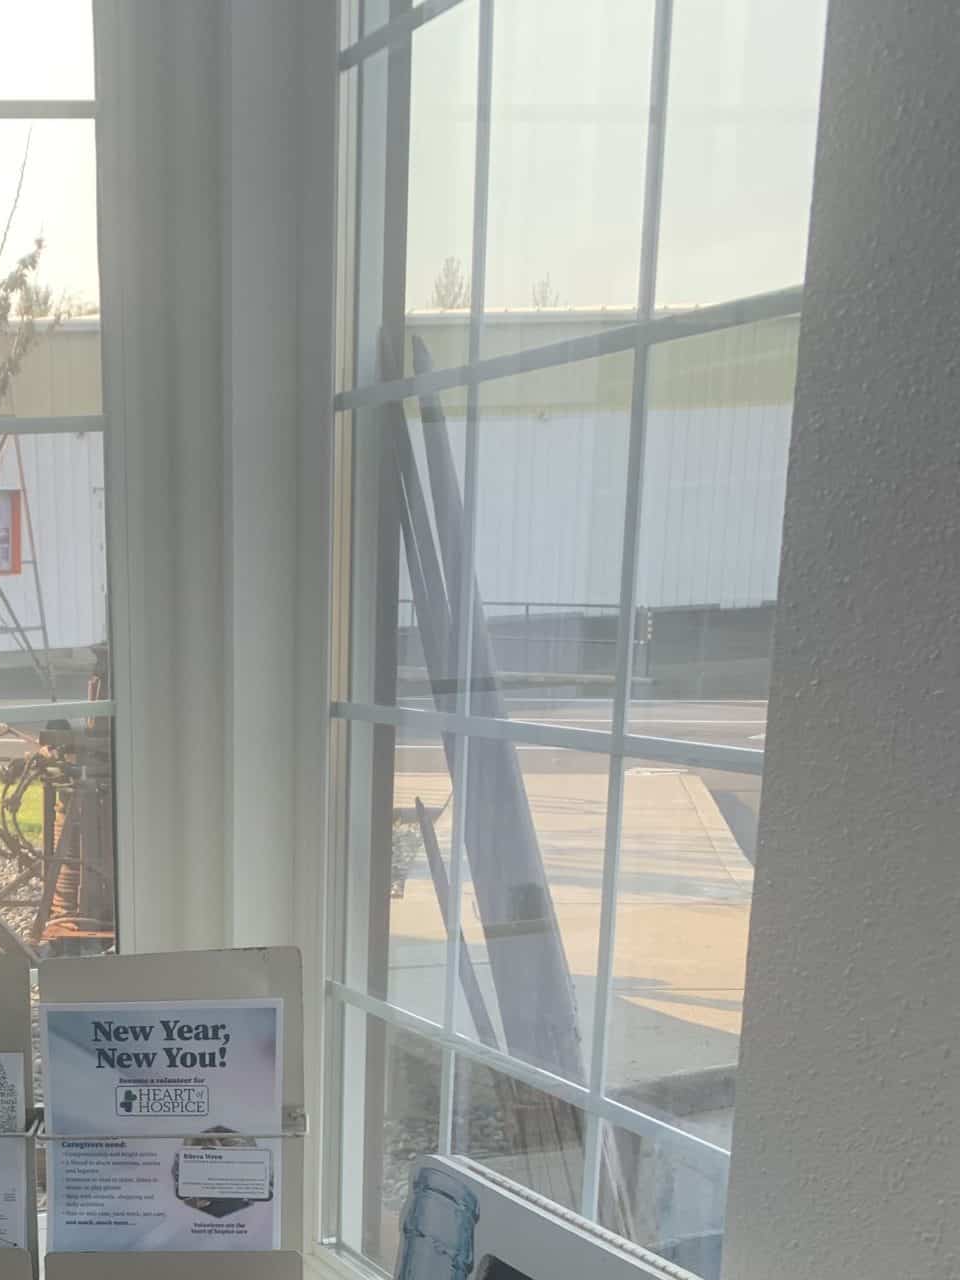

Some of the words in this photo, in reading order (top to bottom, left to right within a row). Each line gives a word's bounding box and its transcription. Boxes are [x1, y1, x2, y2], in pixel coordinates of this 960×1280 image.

[92, 1021, 154, 1042] New
[159, 1020, 231, 1046] Year,
[95, 1048, 157, 1069] New
[162, 1047, 227, 1068] You!
[139, 1088, 195, 1101] HEART
[196, 1091, 204, 1099] of
[139, 1101, 205, 1113] HOSPICE
